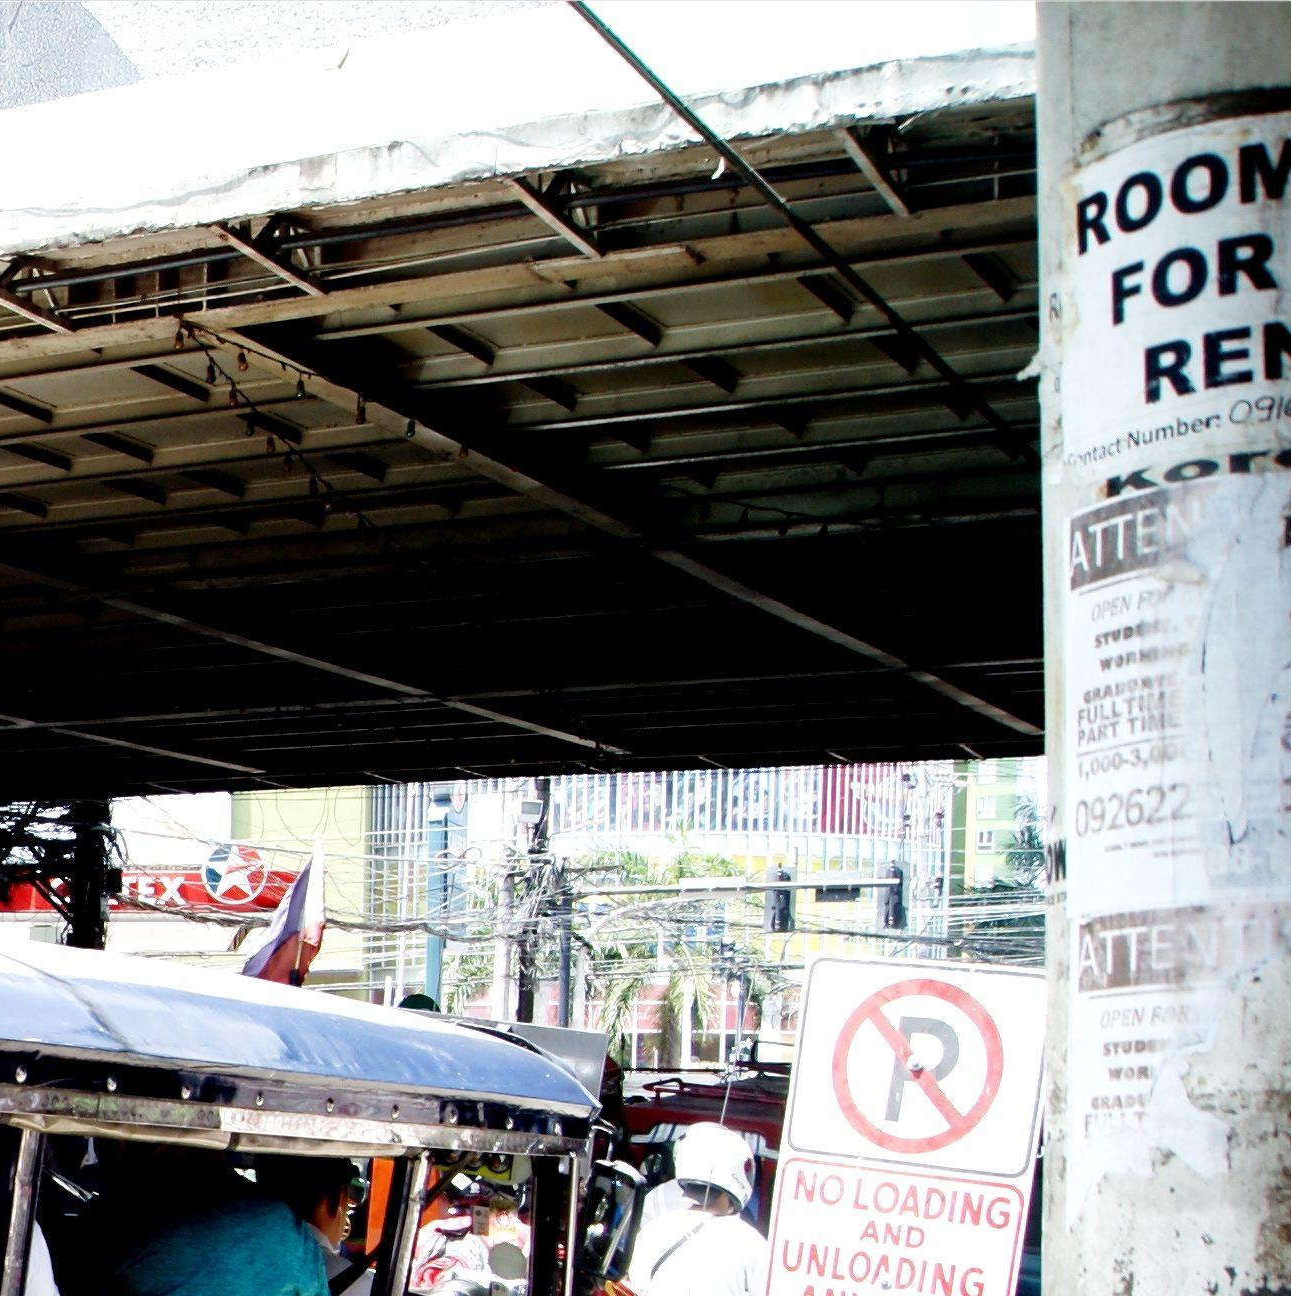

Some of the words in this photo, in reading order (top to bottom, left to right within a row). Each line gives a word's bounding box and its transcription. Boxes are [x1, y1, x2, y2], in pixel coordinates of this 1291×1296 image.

[1112, 233, 1279, 327] FOR
[1126, 414, 1220, 450] Number:
[1092, 593, 1132, 622] OPEN
[1078, 721, 1119, 747] PART
[1100, 1008, 1145, 1029] OPEN
[794, 1169, 844, 1210] NO
[853, 1180, 1012, 1230] LOADING
[860, 1220, 926, 1249] AND
